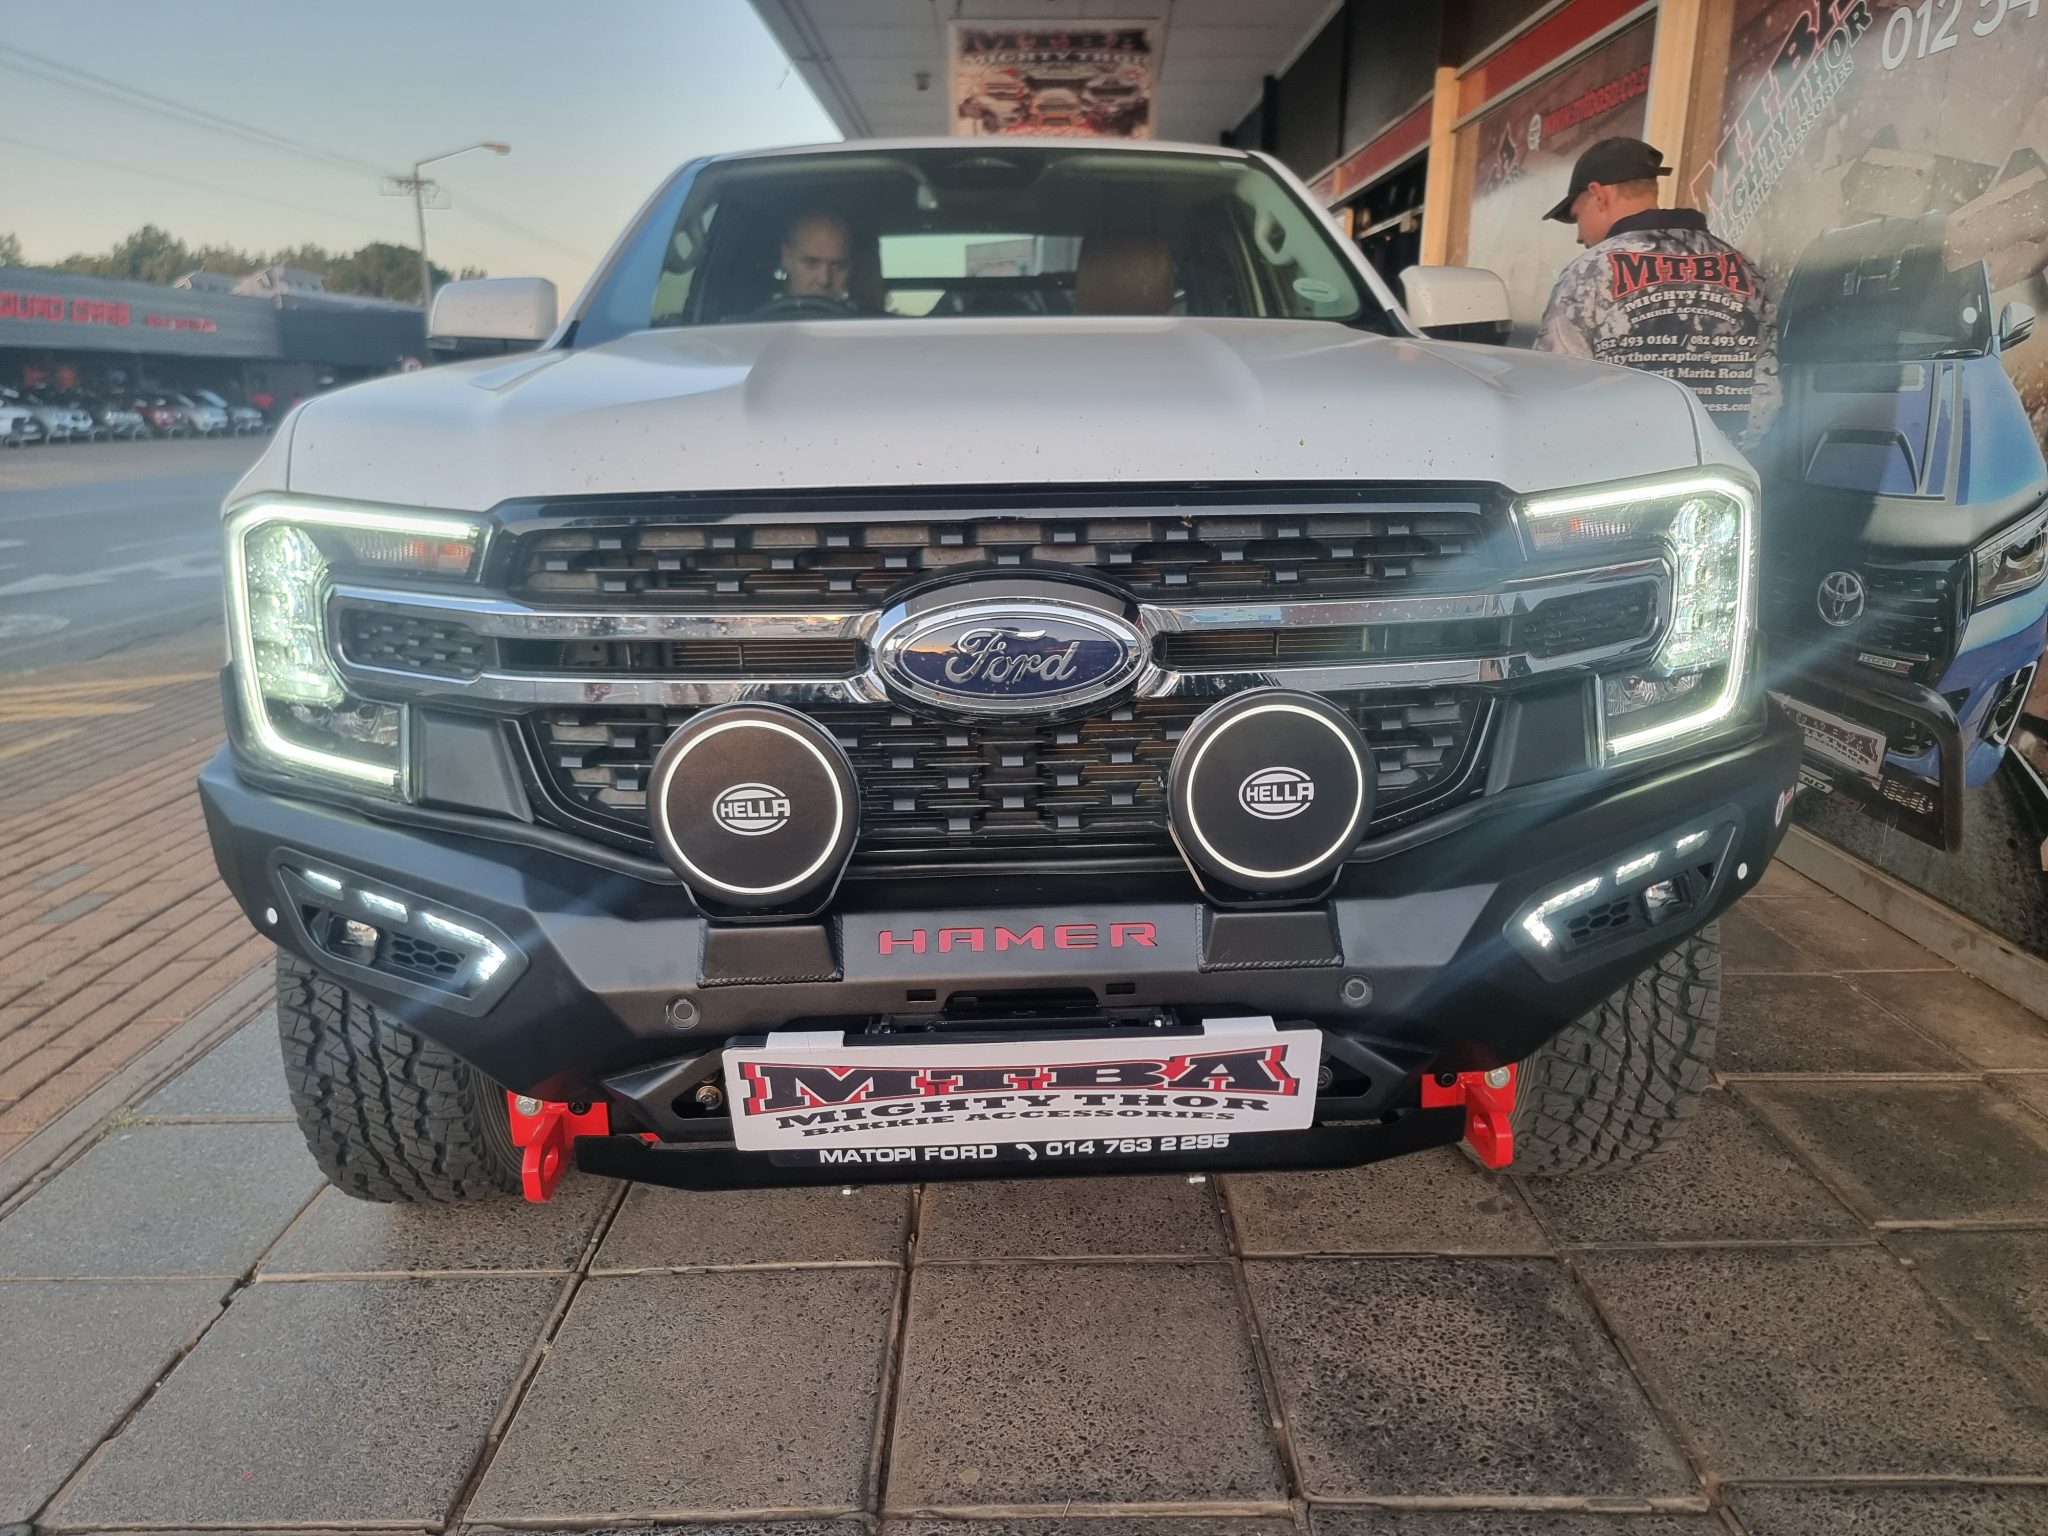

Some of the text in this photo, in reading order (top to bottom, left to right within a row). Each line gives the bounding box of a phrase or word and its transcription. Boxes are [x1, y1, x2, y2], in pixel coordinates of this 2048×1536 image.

[1881, 0, 1962, 71] 012
[1607, 251, 1754, 300] MTBA
[1624, 290, 1744, 313] MIGHTY THOR
[1620, 336, 1644, 347] 493
[1647, 334, 1678, 345] 0161
[1713, 336, 1735, 347] 493
[1677, 367, 1716, 378] Maritz
[1718, 368, 1753, 379] Road
[944, 629, 1080, 687] Ford
[1244, 781, 1315, 804] HELLA
[719, 799, 791, 819] HELLA
[878, 922, 1159, 956] HAMER
[738, 1044, 1300, 1116] MTBA
[776, 1092, 1269, 1130] MIGHTY THOR
[802, 1109, 1236, 1137] BAKKIE ACCESSORIES
[819, 1146, 917, 1163] MATOPI
[924, 1143, 998, 1161] FORD
[1045, 1139, 1098, 1157] 014
[1103, 1137, 1153, 1154] 763
